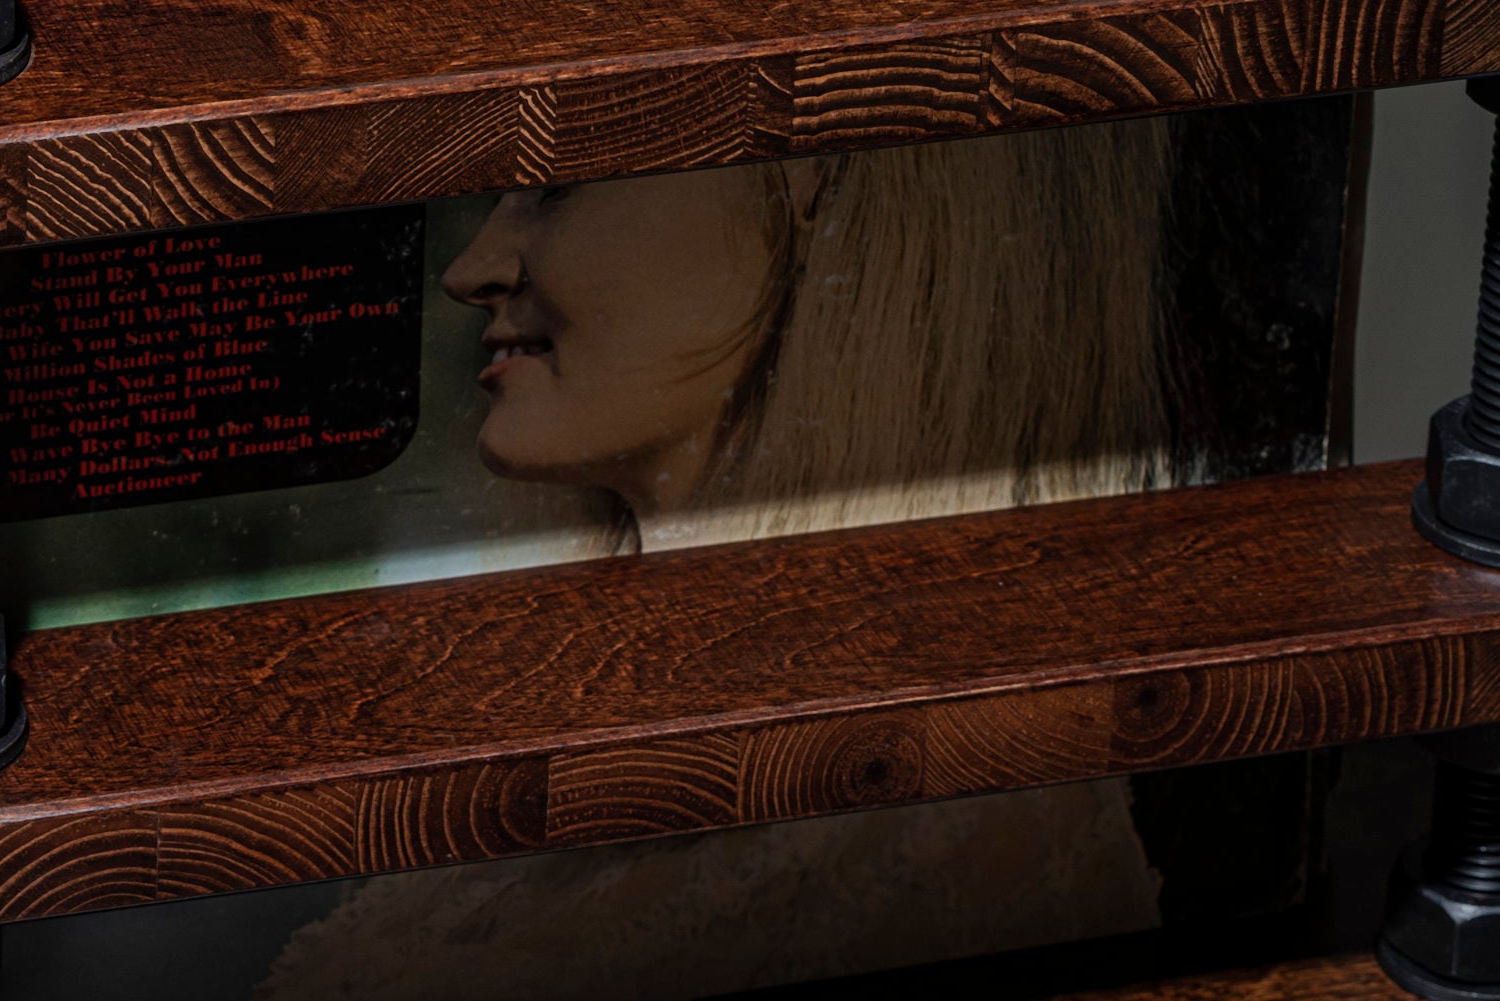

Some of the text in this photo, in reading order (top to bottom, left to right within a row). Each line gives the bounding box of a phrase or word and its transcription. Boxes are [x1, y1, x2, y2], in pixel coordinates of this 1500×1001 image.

[30, 251, 263, 293] Stand By Your Man
[41, 235, 221, 270] Flower of Love
[52, 290, 100, 312] Will
[108, 287, 148, 305] Get
[156, 279, 203, 300] You
[211, 262, 355, 293] Everywhere
[8, 339, 63, 361] Wife
[70, 335, 117, 354] You
[124, 328, 181, 348] Save
[188, 320, 238, 341] May
[245, 314, 277, 332] Be
[283, 306, 343, 327] Your
[348, 301, 400, 320] Own
[56, 307, 136, 334] That'll
[143, 300, 203, 323] Walk
[211, 296, 250, 314] the
[257, 289, 309, 310] Line
[4, 361, 87, 383] Million
[94, 349, 177, 373] Shades
[182, 342, 205, 362] of
[213, 337, 268, 358] Blue
[6, 385, 80, 406] House
[86, 378, 109, 395] Is
[116, 373, 155, 391] Not
[163, 371, 178, 385] a
[184, 363, 253, 383] Home
[60, 397, 121, 414] Never
[126, 391, 177, 407] Been
[184, 378, 243, 399] Loved
[250, 374, 281, 392] In)
[7, 413, 312, 464] Wave Bye Bye to the Man
[30, 402, 197, 441] Be Quiet Mind
[7, 467, 70, 486] Many
[181, 444, 219, 463] Not
[228, 432, 314, 457] Enough
[320, 425, 388, 446] Sense
[71, 470, 203, 499] Auctioneer
